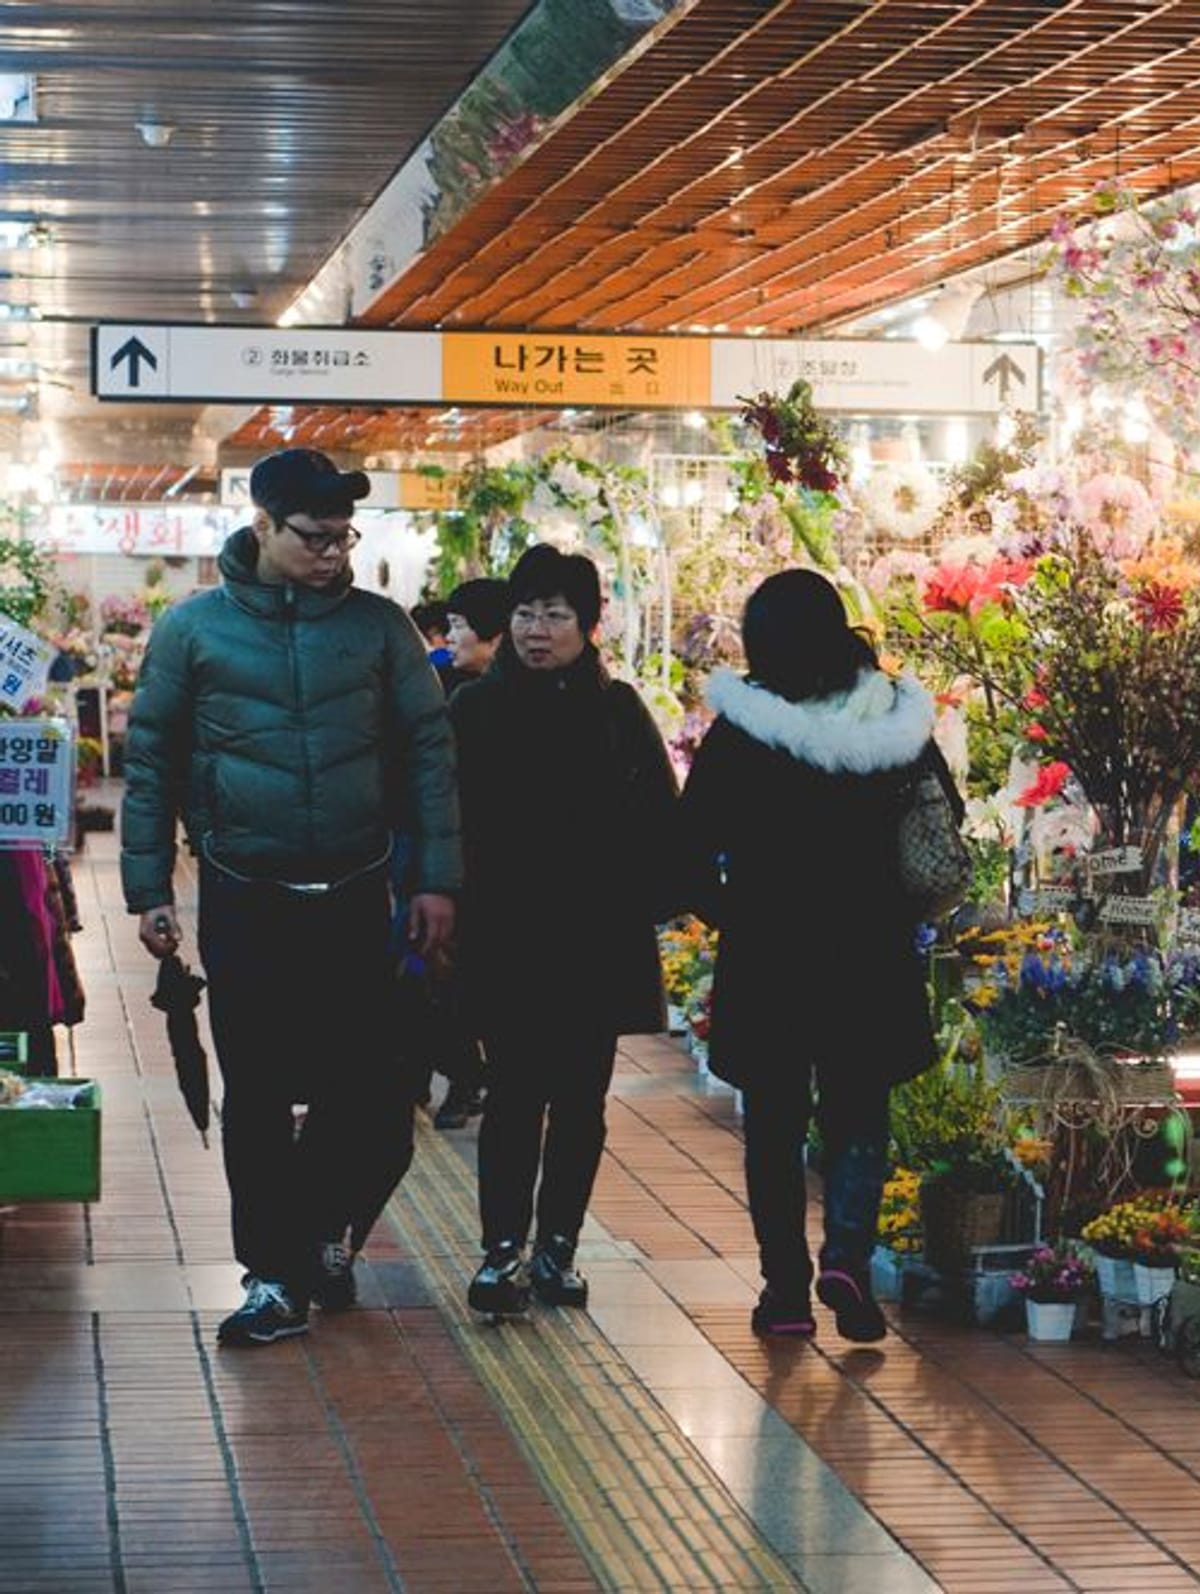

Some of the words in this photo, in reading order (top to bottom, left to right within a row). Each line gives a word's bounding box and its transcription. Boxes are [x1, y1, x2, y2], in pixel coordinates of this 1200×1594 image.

[271, 349, 371, 366] 화물취급소
[494, 344, 605, 373] 나가는
[627, 347, 659, 375] 곳
[494, 379, 529, 394] Way
[535, 379, 564, 393] Out
[35, 803, 56, 827] 원
